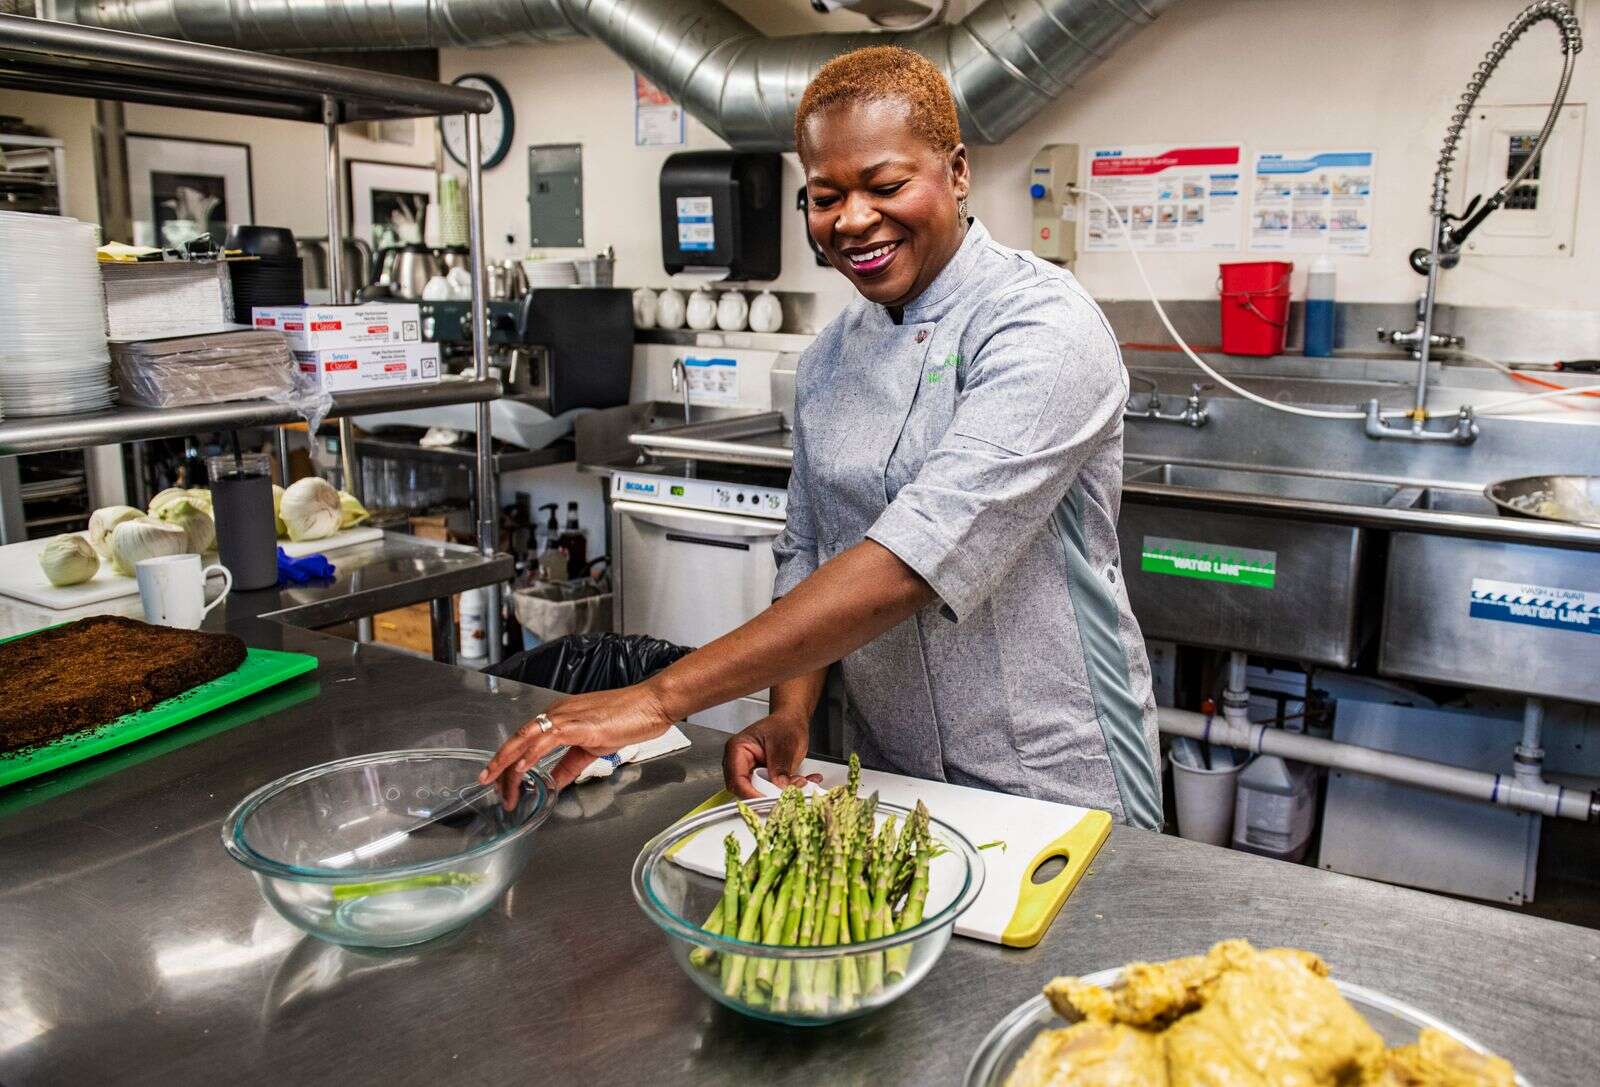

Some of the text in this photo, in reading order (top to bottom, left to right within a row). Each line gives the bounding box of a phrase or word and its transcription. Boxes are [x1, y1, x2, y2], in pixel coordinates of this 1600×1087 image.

[315, 321, 338, 330] Classic
[329, 361, 353, 371] Classic
[625, 482, 654, 492] ECOLAB
[1173, 559, 1240, 577] WATER LINE
[1509, 604, 1590, 625] WATER LINE
